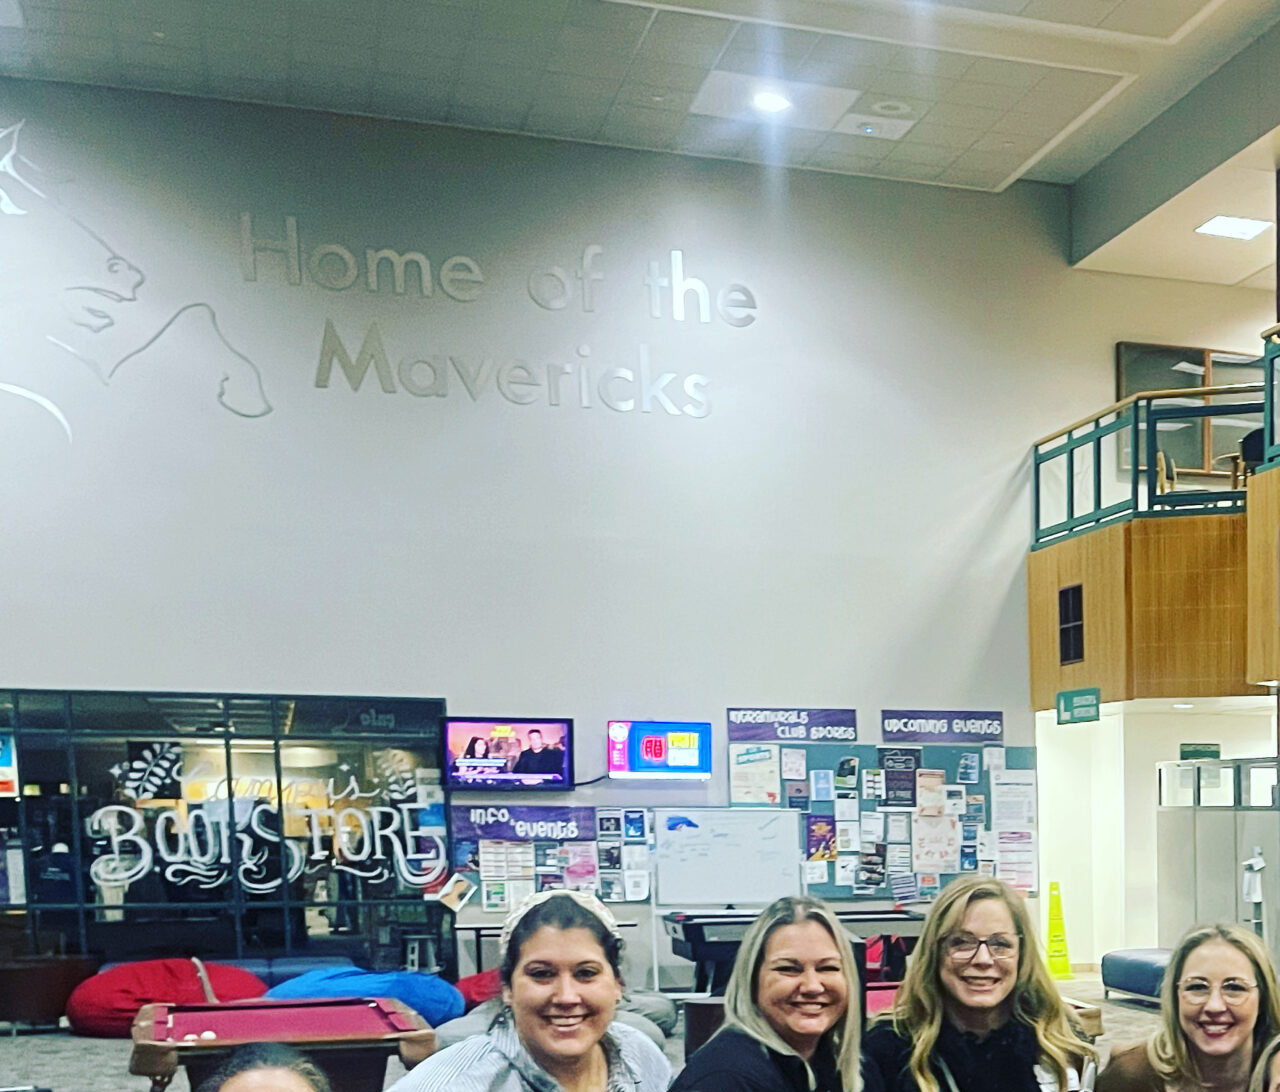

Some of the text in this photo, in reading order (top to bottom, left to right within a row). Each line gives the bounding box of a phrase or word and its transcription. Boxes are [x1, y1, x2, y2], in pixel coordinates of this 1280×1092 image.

[240, 212, 757, 327] Home of the
[314, 317, 712, 418] Mavericks
